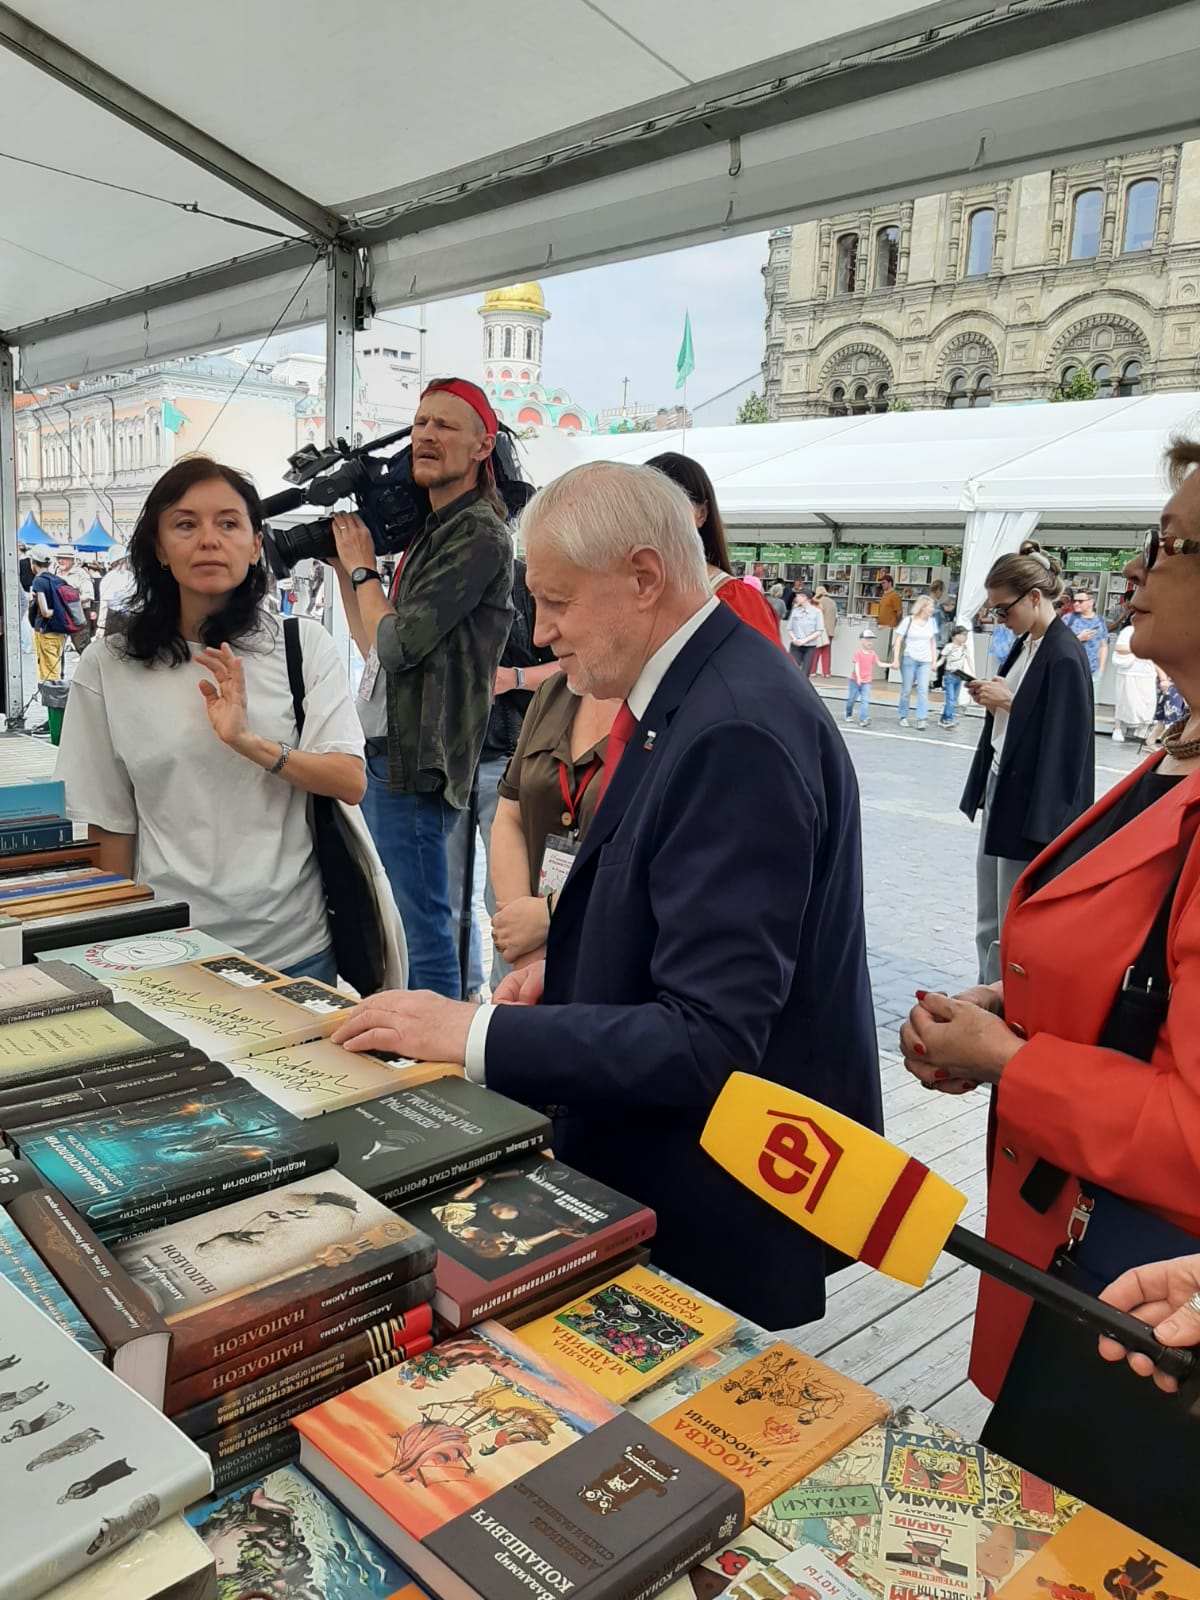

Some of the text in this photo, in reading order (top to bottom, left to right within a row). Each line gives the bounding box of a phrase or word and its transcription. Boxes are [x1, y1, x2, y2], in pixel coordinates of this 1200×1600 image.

[378, 1096, 442, 1129] «ЛЕНИНГРАД
[456, 1117, 484, 1135] СТАЛ
[44, 1135, 112, 1195] МЕДИААКСИОЛОГИЯ
[428, 1170, 451, 1184] СТАЛ
[450, 1150, 502, 1175] «ЛЕНИНГРАД
[118, 1159, 306, 1220] МЕДИААКСИОЛОГИЯ «ВТОРОЙ РЕАЛЬНОСТИ»
[160, 1244, 217, 1295] НАПОЛЕОН
[556, 1250, 597, 1276] МИФОЛОГИЯ
[212, 1272, 394, 1358] Александр Дюма НАПОЛЕОН
[471, 1290, 511, 1318] КУЛЬТУРЫ
[631, 1282, 704, 1324] СКАЗОЧНЫЕ
[649, 1283, 702, 1314] КОТЫ
[211, 1302, 392, 1390] Александр Дюма НАПОЛЕОН
[550, 1325, 629, 1376] МАВРИНА
[551, 1339, 602, 1375] ТАТЬЯНА
[217, 1360, 345, 1425] ВЕЛИКАЯ ОТЕЧЕСТВЕННАЯ ВОЙНА
[218, 1439, 246, 1458] ВОЙНА
[674, 1418, 760, 1480] МОСКВА
[684, 1409, 771, 1468] И МОСКВИЧИ
[890, 1431, 976, 1456] РАДУГА
[782, 1494, 870, 1512] ЗАГАДКИ
[470, 1508, 575, 1594] КОНАШЕВИЧ
[494, 1550, 556, 1600] Владимир
